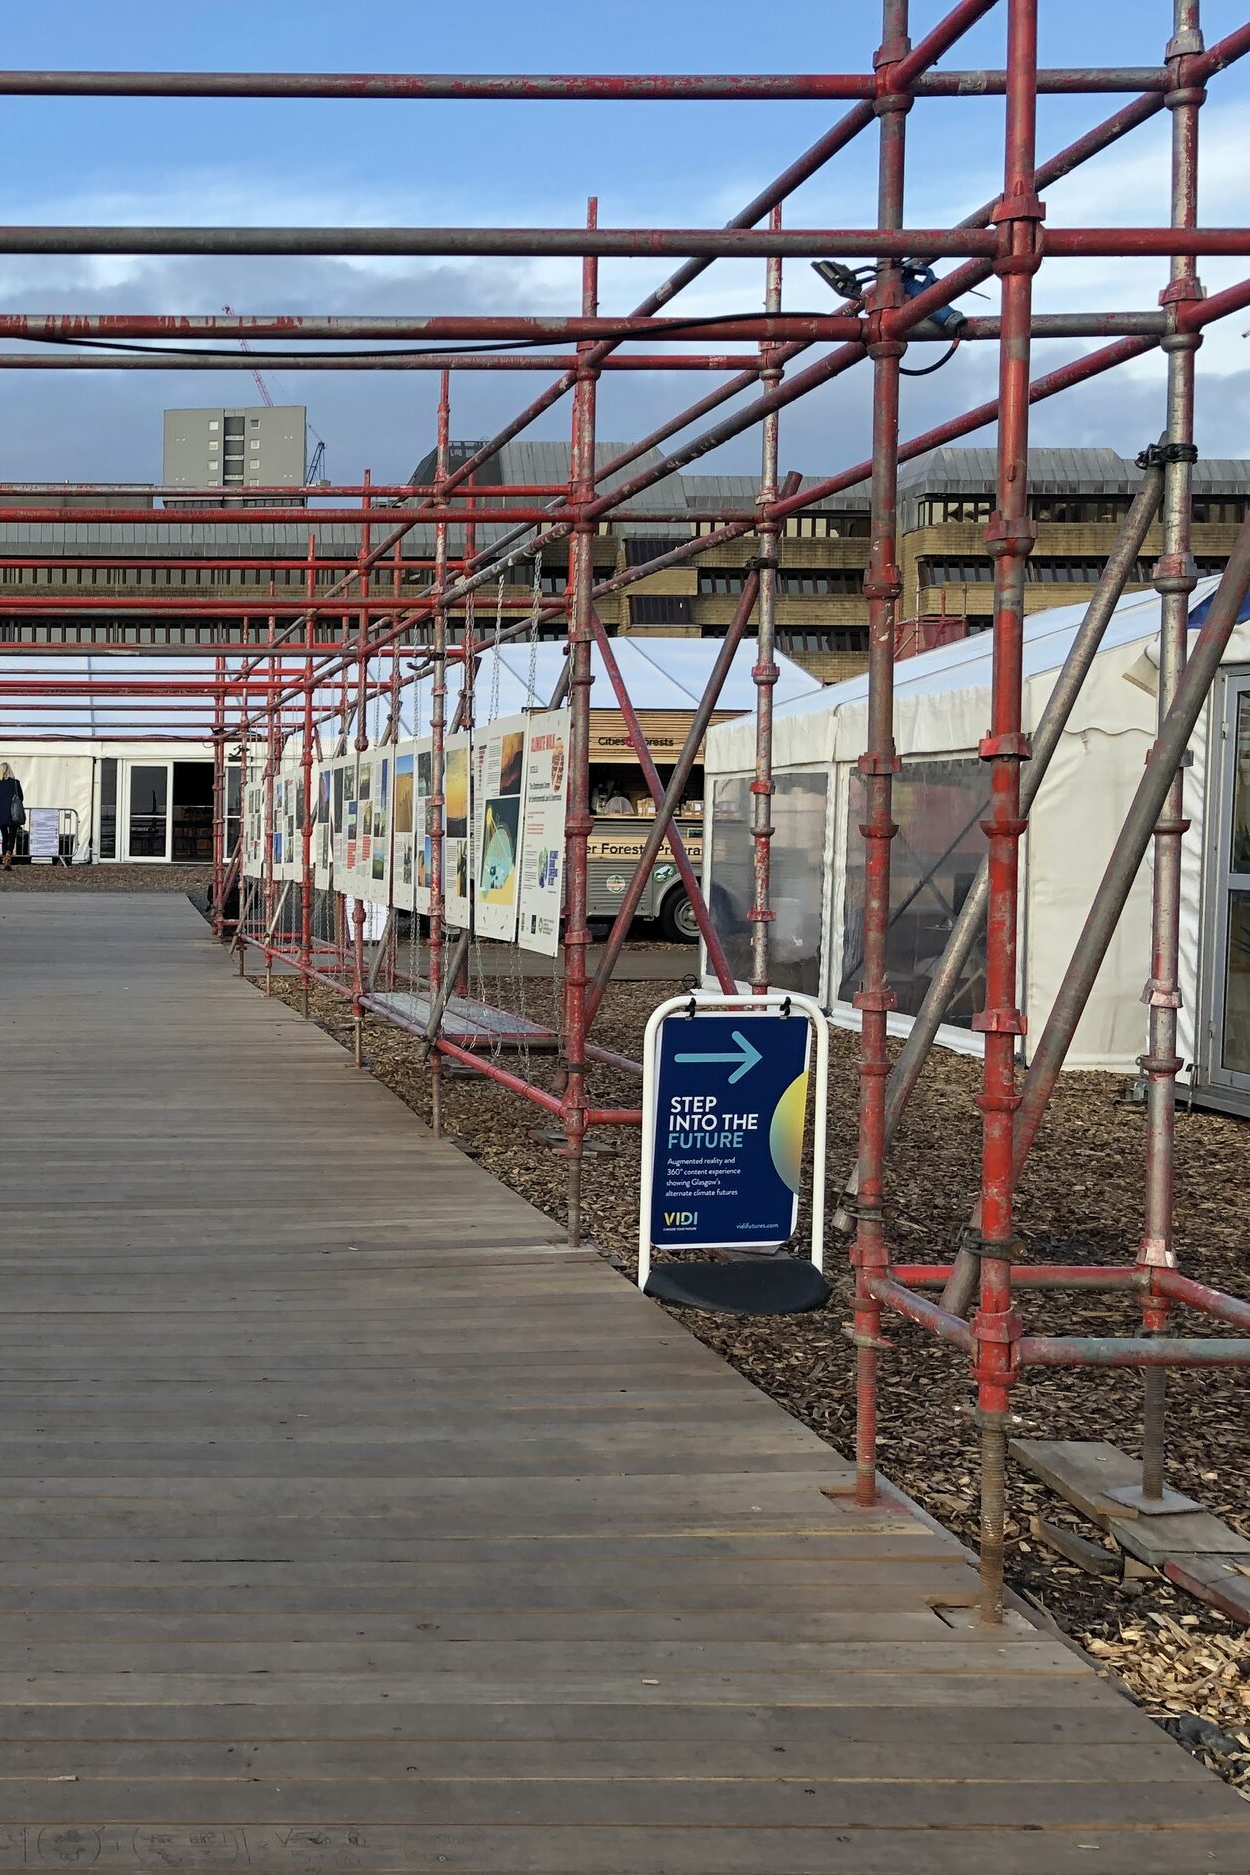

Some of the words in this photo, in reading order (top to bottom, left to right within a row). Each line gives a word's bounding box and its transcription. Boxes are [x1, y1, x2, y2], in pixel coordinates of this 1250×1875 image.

[671, 1096, 717, 1113] STEP
[669, 1114, 717, 1131] INTO
[722, 1114, 758, 1130] THE
[668, 1132, 744, 1149] FUTURE
[667, 1158, 704, 1168] Augmented
[704, 1157, 723, 1166] reality
[724, 1157, 737, 1165] and
[708, 1168, 741, 1178] experience
[665, 1179, 691, 1188] showing
[665, 1189, 692, 1198] alternate
[693, 1189, 716, 1197] climate
[716, 1188, 738, 1197] futures
[664, 1211, 698, 1226] VIDI
